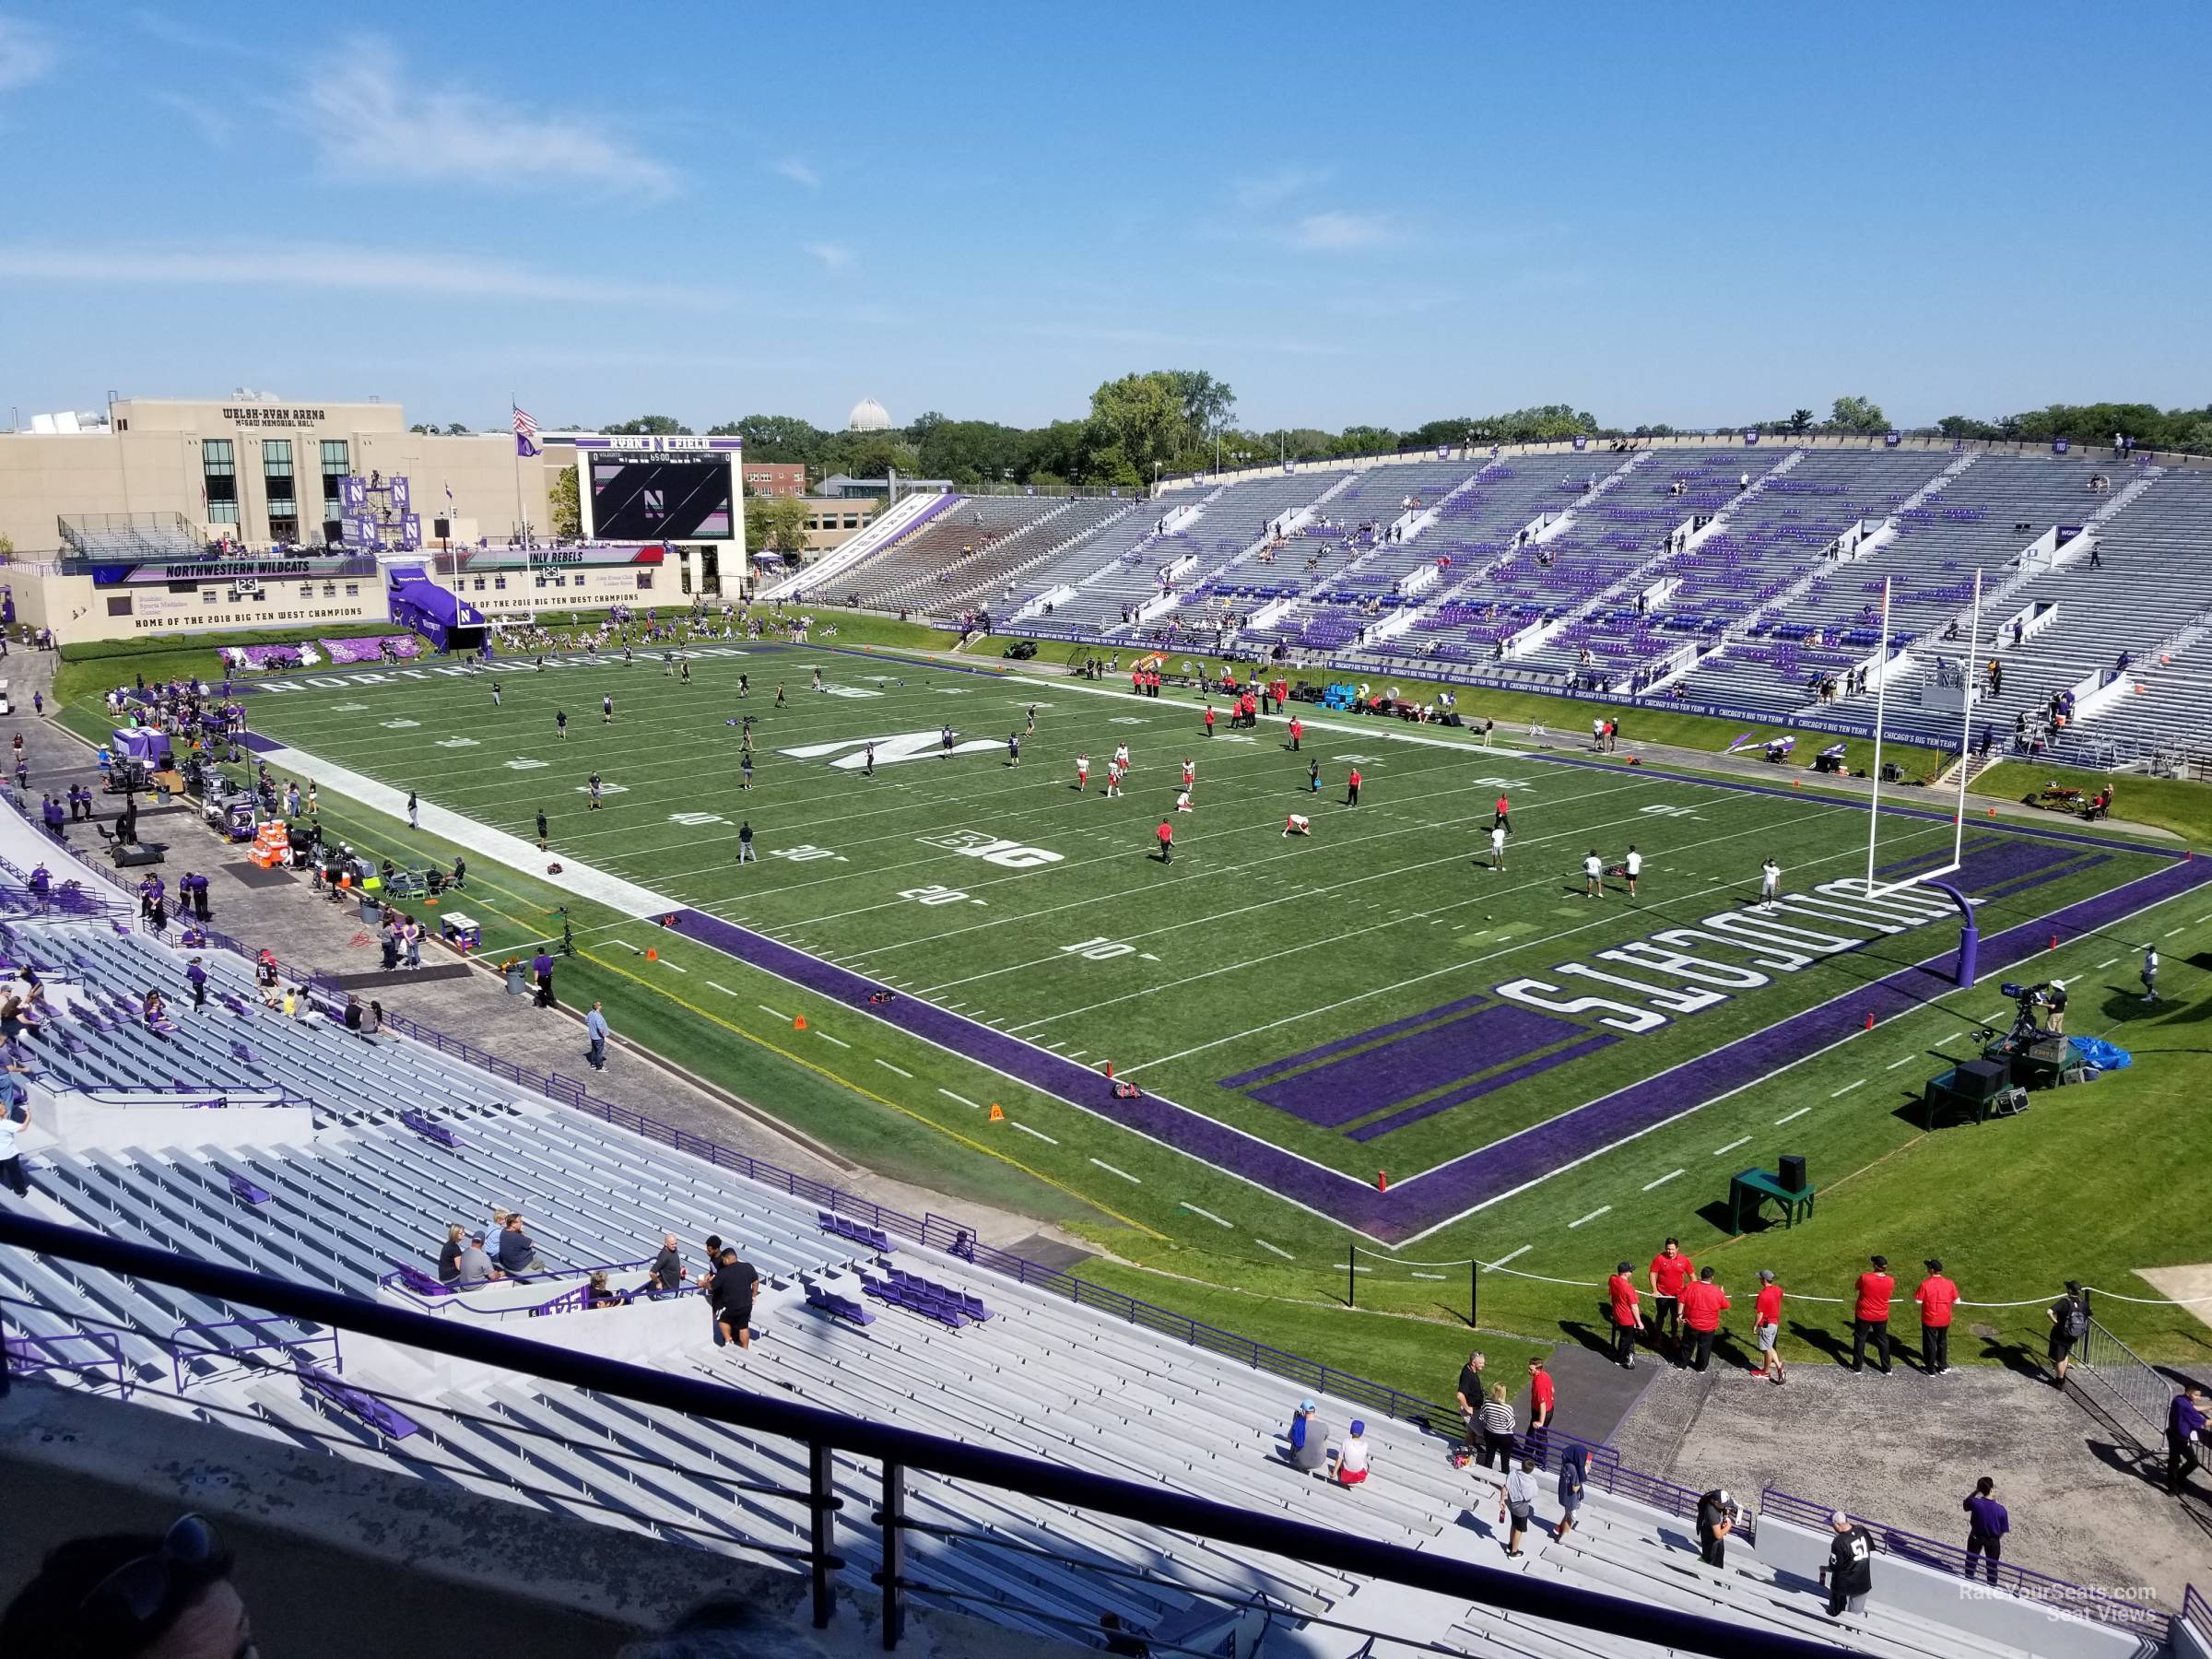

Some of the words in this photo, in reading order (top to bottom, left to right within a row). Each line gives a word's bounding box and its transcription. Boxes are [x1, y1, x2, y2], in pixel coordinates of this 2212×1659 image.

[223, 408, 289, 419] WELSH-RYAN
[293, 409, 325, 419] ARENA
[610, 438, 643, 450] RYAN
[676, 438, 710, 450] FIELD
[351, 485, 363, 501] N
[394, 485, 406, 501] N
[644, 489, 665, 518] N
[362, 523, 375, 538] N
[406, 522, 418, 538] N
[551, 551, 583, 562] REBELS
[166, 562, 254, 578] NORTHWESTERN
[258, 560, 310, 574] WILDCATS
[240, 579, 255, 590] 25
[571, 595, 592, 604] WEST
[594, 594, 639, 603] CHAMPIONS
[135, 618, 163, 627] HOME
[167, 618, 179, 626] OF
[184, 616, 204, 625] THE
[207, 615, 230, 623] 2018
[235, 614, 252, 622] BIG
[278, 611, 304, 619] WEST
[309, 607, 362, 618] CHAMPIONS
[253, 646, 750, 693] NORTHWESTERN
[1644, 699, 1669, 708] CHICAGO'S
[1719, 708, 1745, 718] CHICAGO'S
[1768, 715, 1783, 724] TEAM
[1798, 719, 1827, 729] CHICAGO'S
[1827, 723, 1837, 731] BIG
[1851, 726, 1867, 735] TEAM
[1883, 731, 1913, 742] CHICAGO'S
[1914, 735, 1924, 744] BIG
[1926, 737, 1939, 746] TEN
[1940, 739, 1957, 748] TEAM
[769, 843, 835, 862] 30
[896, 884, 970, 906] 20
[1060, 936, 1136, 960] 10
[1492, 877, 1983, 1034] WILDCATS
[1850, 1535, 1869, 1561] 51
